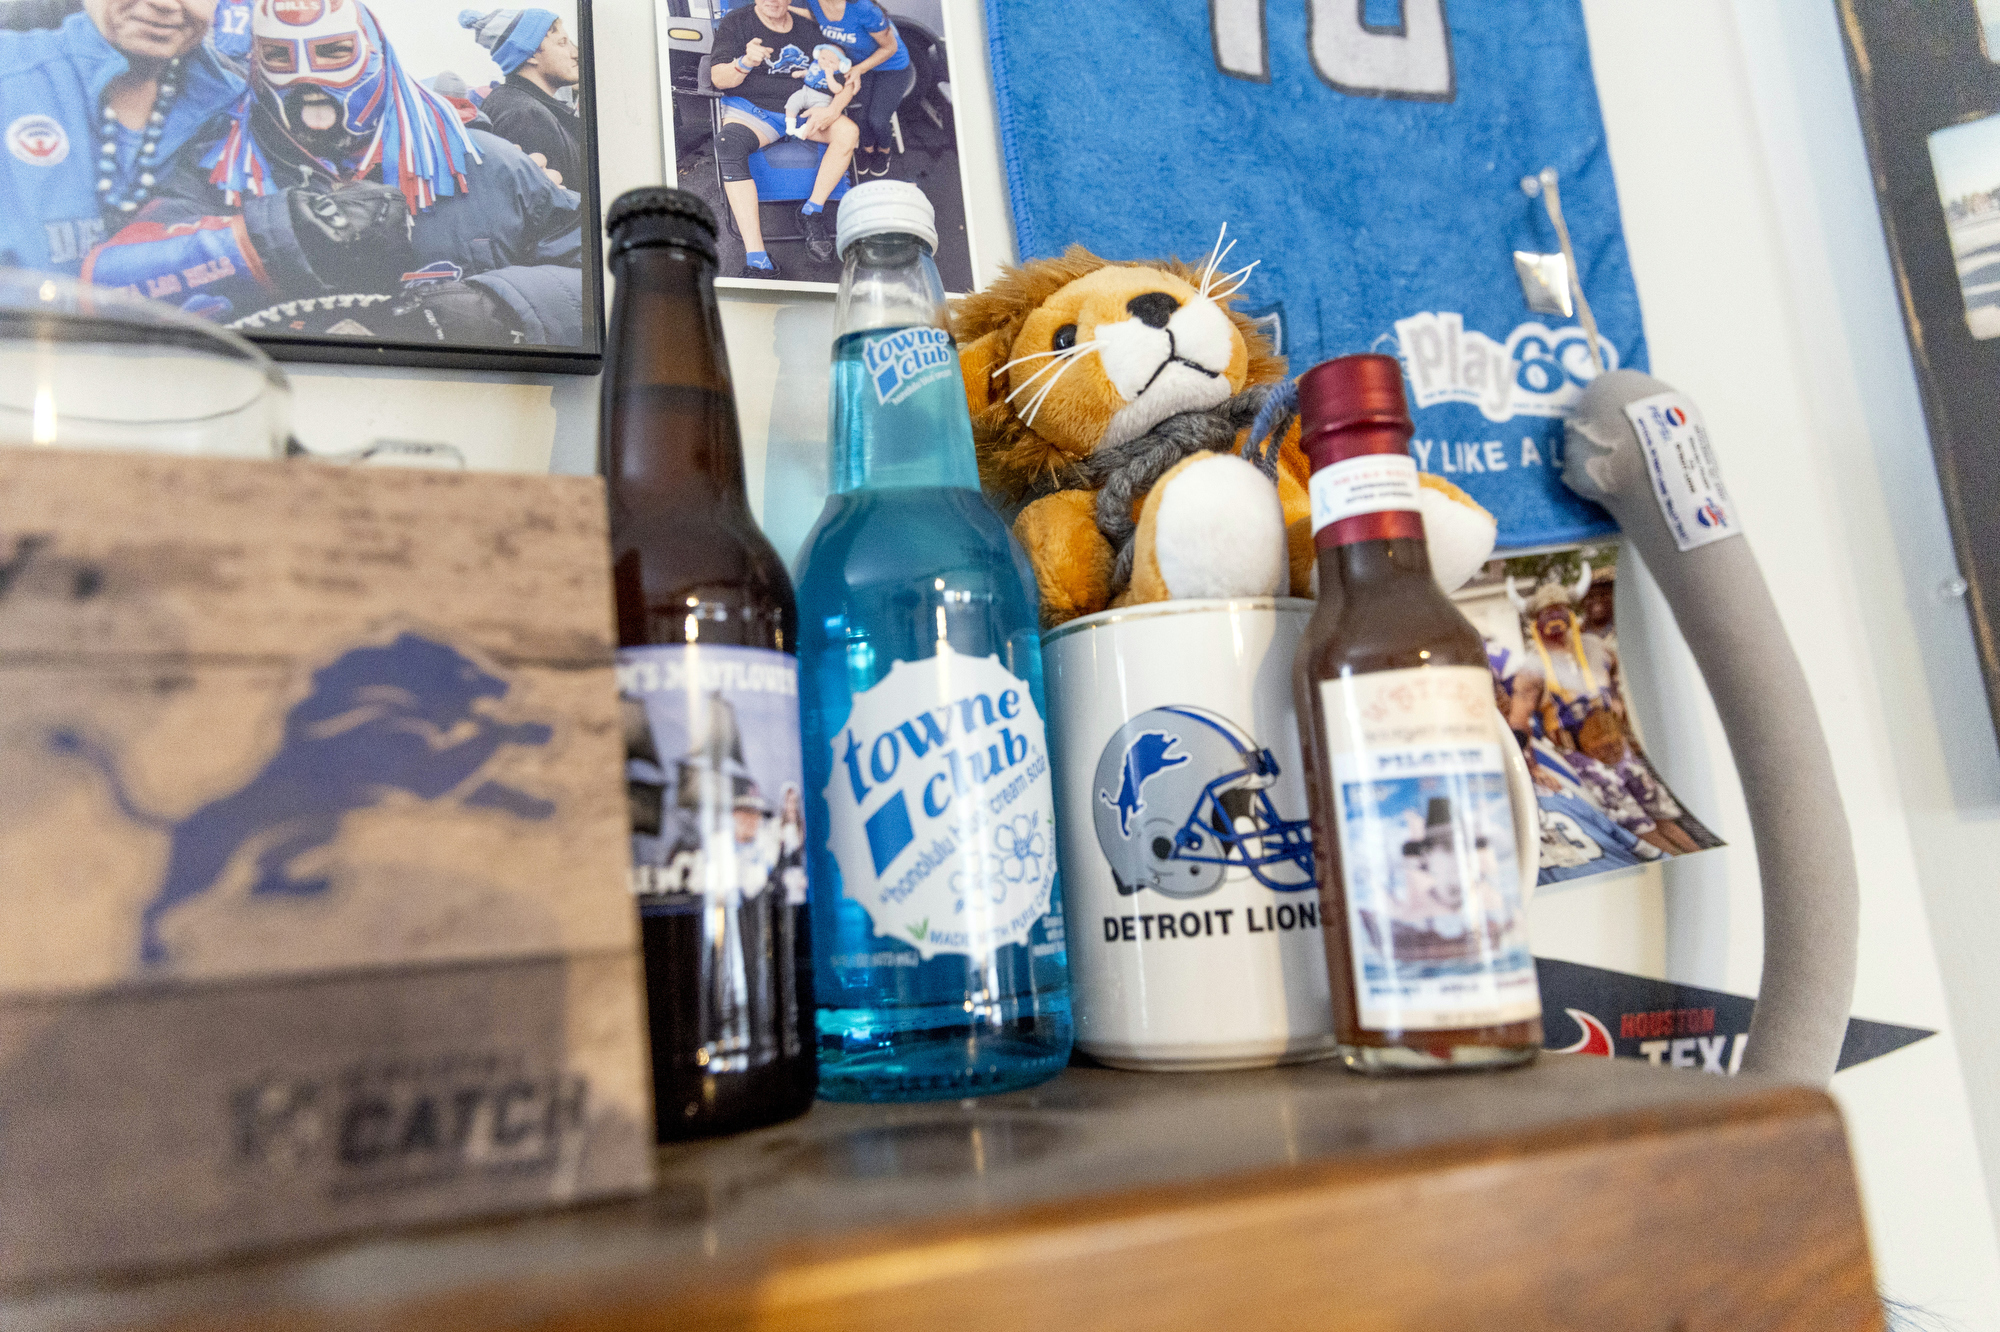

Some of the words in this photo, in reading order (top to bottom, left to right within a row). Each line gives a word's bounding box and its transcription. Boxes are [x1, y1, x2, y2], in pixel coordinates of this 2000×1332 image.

[221, 8, 249, 35] 17
[275, 1, 320, 11] BILLS
[866, 329, 945, 371] towne
[902, 346, 950, 376] club
[1406, 318, 1518, 415] Play
[1441, 440, 1508, 474] LIKE
[1520, 436, 1542, 468] A
[842, 688, 1021, 806] towne
[922, 728, 1029, 818] club
[990, 773, 1028, 815] cream
[1103, 909, 1233, 943] DETROIT
[1247, 902, 1320, 933] LION
[1621, 1008, 1716, 1039] HOUSTON
